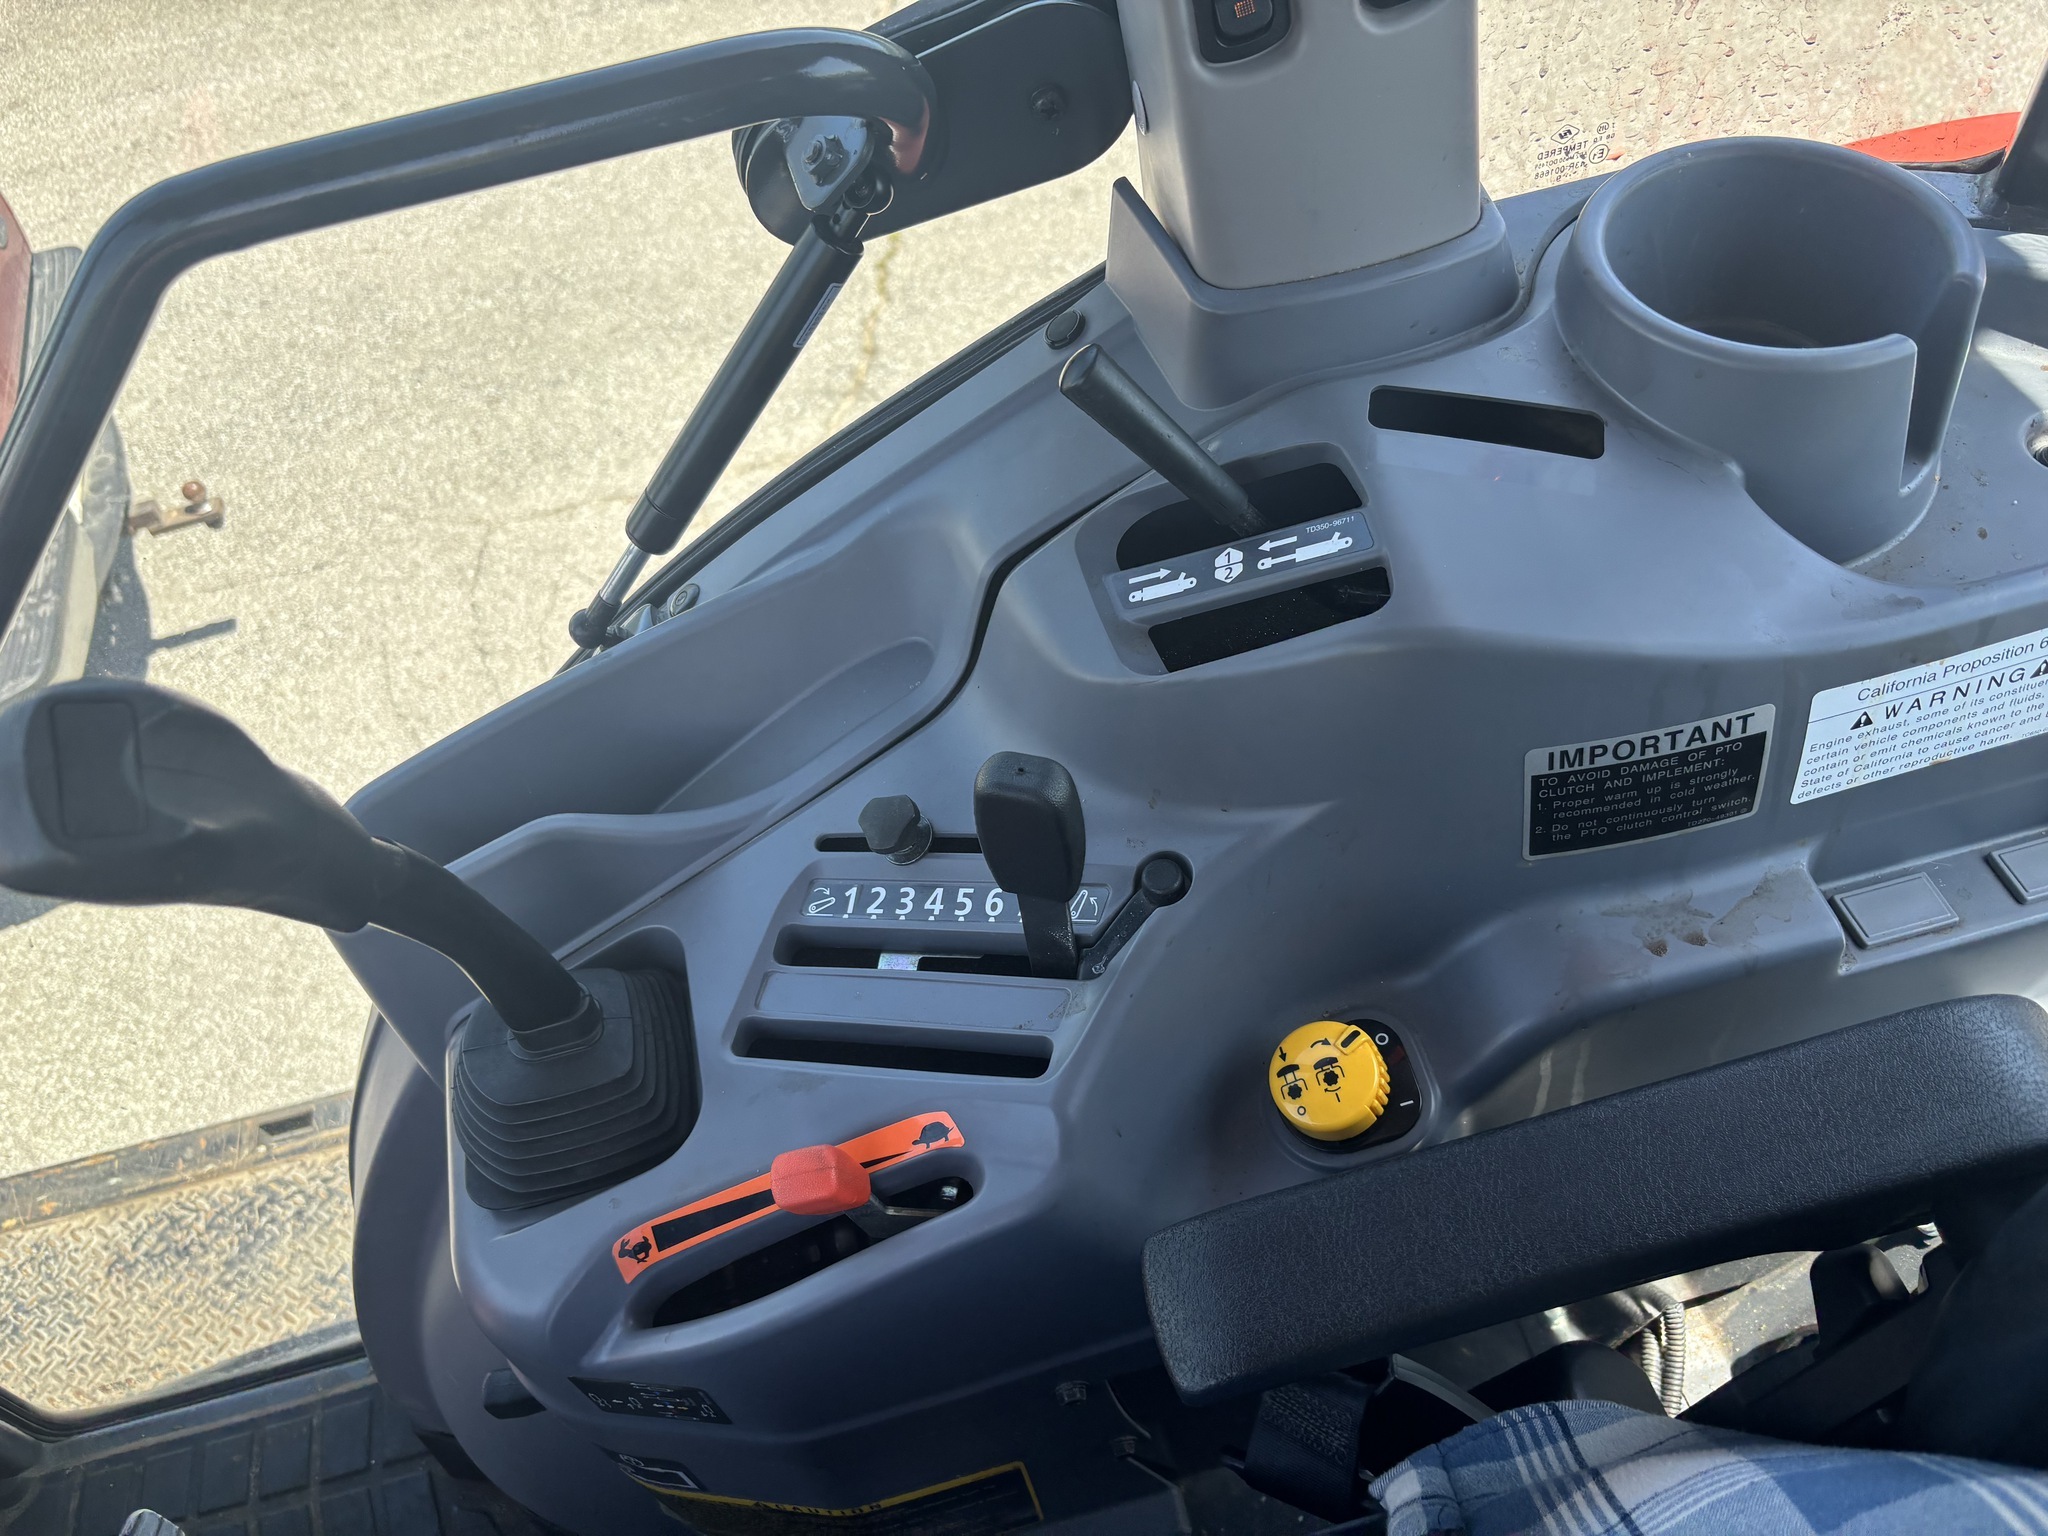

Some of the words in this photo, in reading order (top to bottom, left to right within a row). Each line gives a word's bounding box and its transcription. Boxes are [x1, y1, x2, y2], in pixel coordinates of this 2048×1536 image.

[1305, 515, 1355, 534] TD350-96711
[1224, 552, 1231, 564] 1
[1224, 567, 1233, 580] 2
[1858, 673, 1937, 701] California
[1943, 643, 2034, 684] Proposition
[1886, 668, 2026, 720] WARNING
[1548, 713, 1755, 771] IMPORTANT
[1804, 760, 1848, 777] contain
[1853, 753, 1867, 763] or
[1870, 744, 1897, 758] emit
[1901, 725, 1963, 749] chemicals
[1967, 714, 2006, 730] known
[2010, 707, 2022, 718] to
[2026, 702, 2044, 713] the
[1807, 748, 1849, 765] certain
[1854, 733, 1897, 751] vehicle
[1902, 711, 1977, 738] components
[1982, 702, 2004, 715] and
[1810, 734, 1852, 752] Engine
[1916, 709, 1949, 723] some
[1953, 701, 1966, 712] of
[1970, 696, 1984, 706] its
[1539, 777, 1559, 787] TO
[1570, 769, 1610, 783] AVOID
[1621, 757, 1678, 775] DAMAGE
[1688, 750, 1707, 762] OF
[1716, 742, 1742, 756] PTO
[1798, 782, 1842, 799] defects
[1846, 776, 1860, 785] or
[1863, 766, 1895, 781] other
[1899, 744, 1975, 770] reproductive
[1980, 733, 2013, 747] harm.
[1801, 774, 1832, 788] State
[1837, 768, 1850, 778] of
[1854, 751, 1913, 773] California
[1918, 746, 1929, 755] to
[1934, 734, 1969, 750] cause
[1974, 721, 2016, 739] cancer
[2019, 714, 2041, 726] and
[1537, 803, 1547, 811] 1.
[1553, 797, 1596, 811] Proper
[1605, 790, 1637, 801] warm
[1647, 786, 1661, 795] up
[1671, 781, 1681, 789] is
[1690, 767, 1739, 786] strongly
[1539, 784, 1595, 798] CLUTCH
[1604, 778, 1633, 789] AND
[1642, 758, 1725, 783] IMPLEMENT:
[1553, 799, 1641, 819] recommended
[1651, 794, 1661, 804] in
[1670, 788, 1695, 799] cold
[1704, 774, 1755, 791] weather.
[1536, 826, 1546, 834] 2.
[1553, 823, 1569, 832] Do
[1578, 819, 1598, 828] not
[1606, 803, 1684, 825] continuously
[1692, 796, 1715, 807] turn
[1553, 832, 1571, 841] the
[1581, 827, 1608, 838] PTO
[1616, 819, 1653, 832] clutch
[1662, 809, 1703, 823] control
[1711, 796, 1751, 811] switch.
[845, 887, 857, 914] 1
[867, 887, 887, 914] 2
[895, 888, 916, 915] 3
[924, 888, 944, 915] 4
[954, 888, 975, 916] 5
[985, 888, 1004, 916] 6
